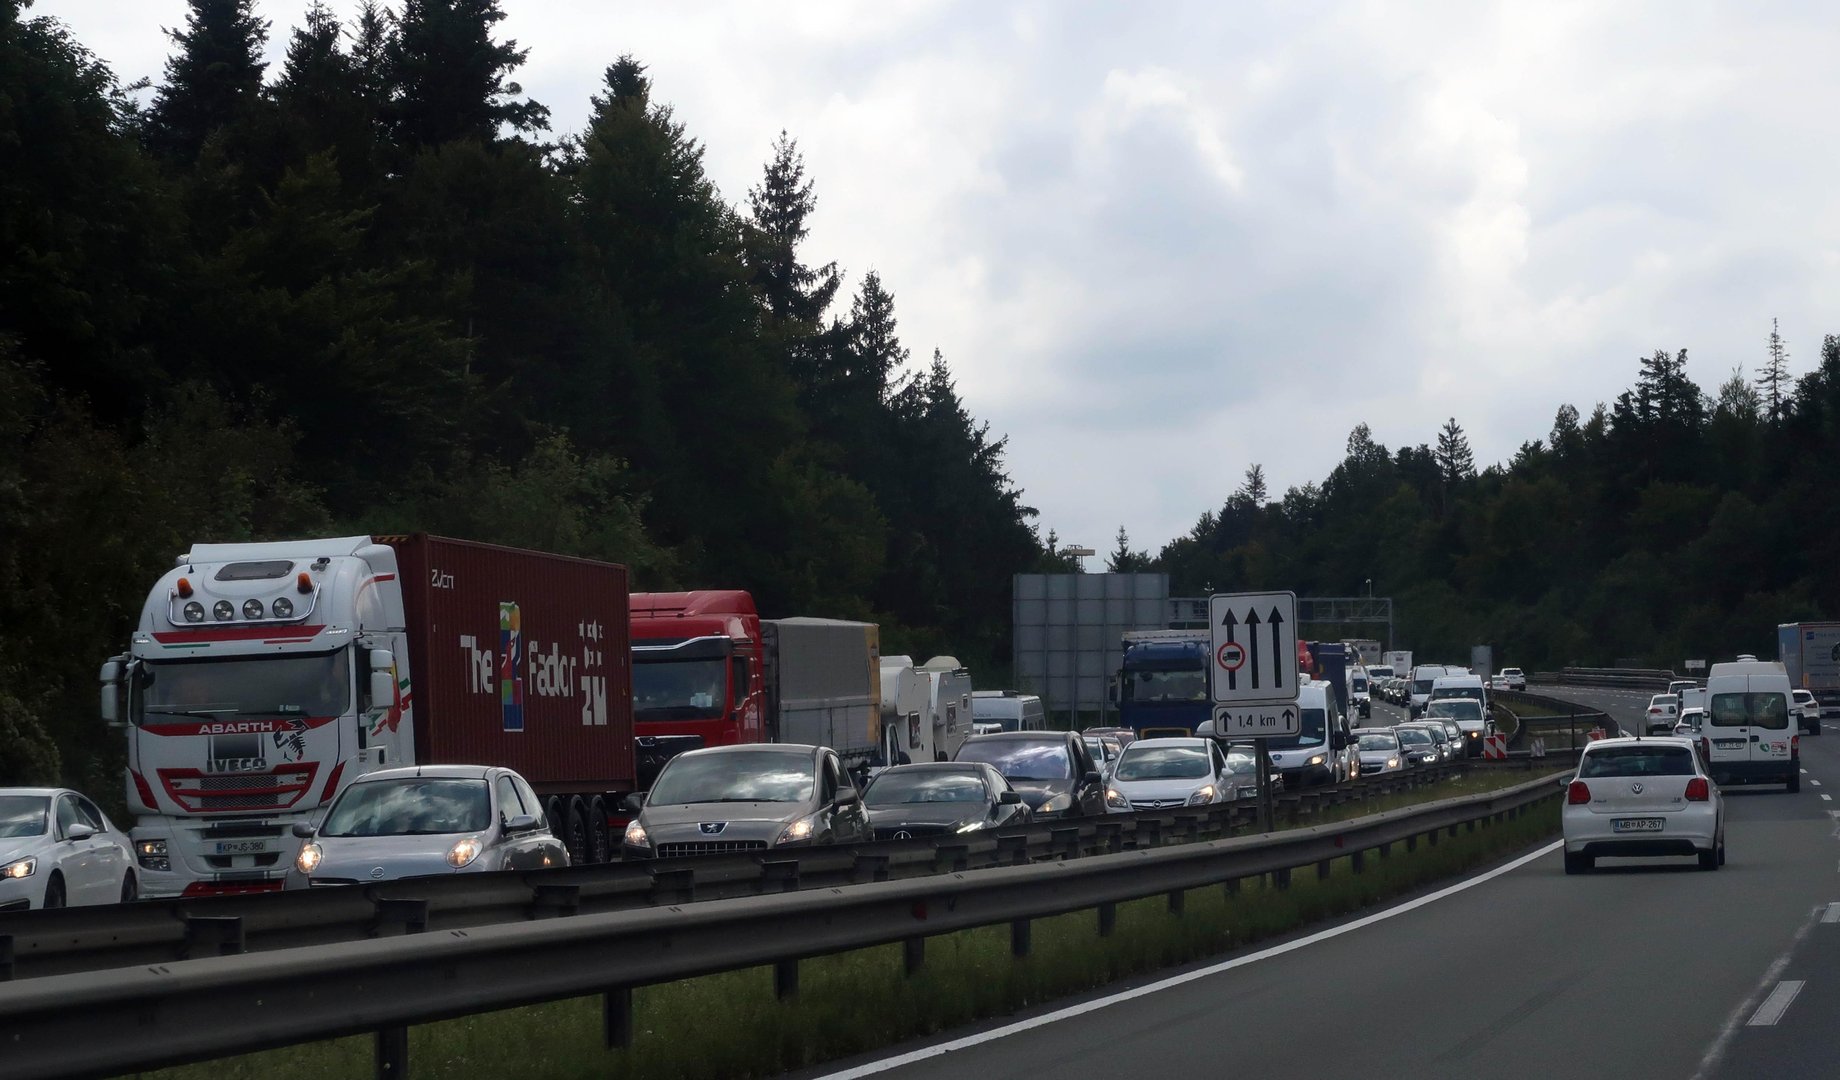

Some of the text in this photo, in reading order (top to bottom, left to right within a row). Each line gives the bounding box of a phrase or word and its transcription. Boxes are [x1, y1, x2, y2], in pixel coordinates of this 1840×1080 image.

[459, 635, 494, 694] The
[198, 721, 273, 735] ABARTH
[1239, 714, 1276, 728] 1,4 km
[206, 758, 267, 773] IVECO
